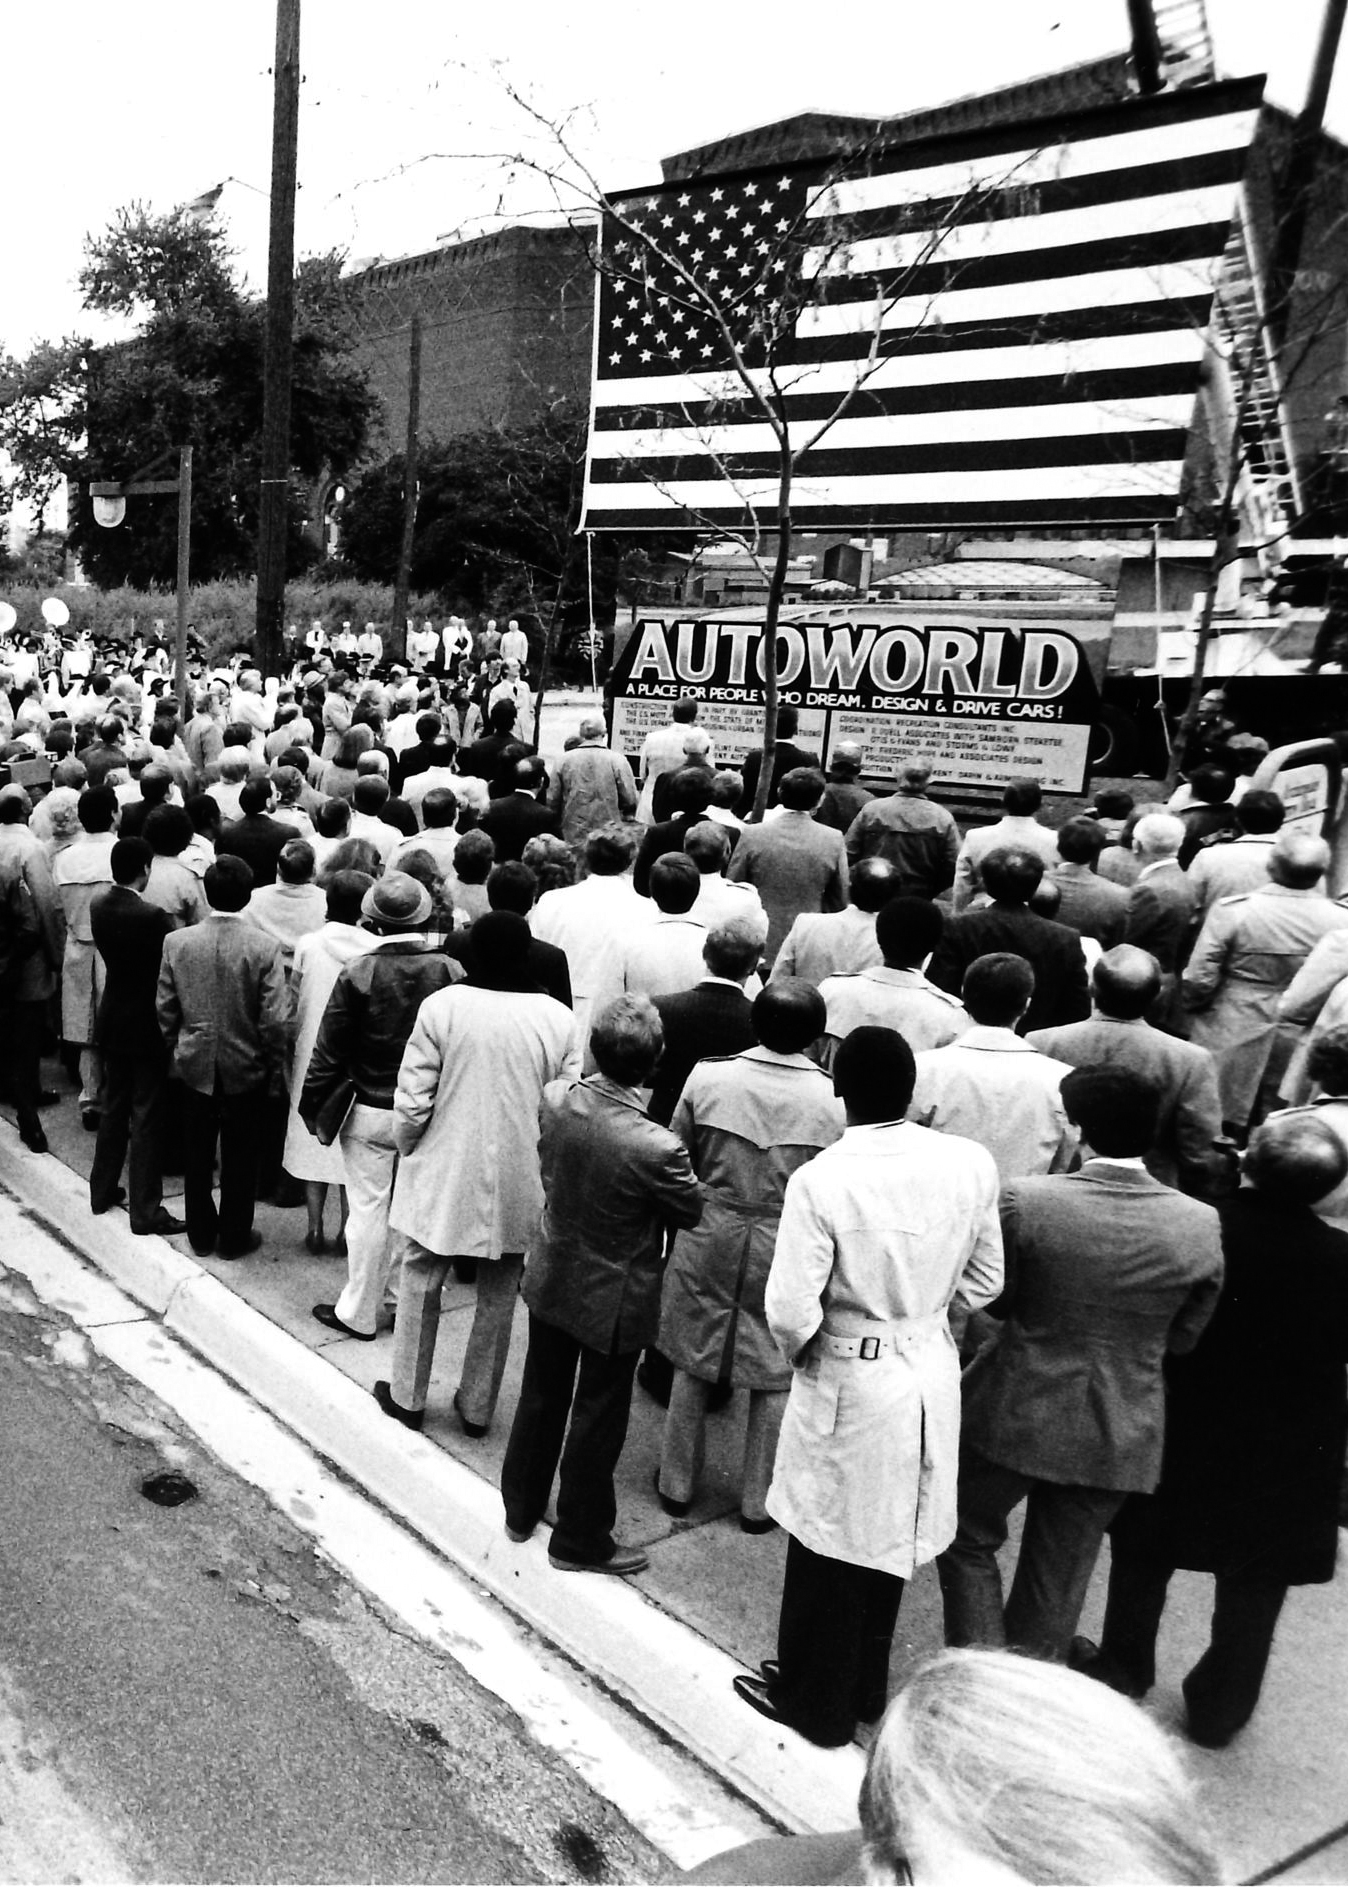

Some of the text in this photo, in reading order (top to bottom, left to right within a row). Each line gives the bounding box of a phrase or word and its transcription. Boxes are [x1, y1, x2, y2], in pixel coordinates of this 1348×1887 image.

[628, 622, 1079, 699] AUTOWORLD
[626, 684, 635, 695] A
[638, 684, 678, 698] PLACE
[680, 686, 707, 699] FOR
[709, 687, 758, 702] PEOPLE
[871, 696, 929, 712] DESIGN
[935, 700, 947, 713] &
[952, 700, 1001, 716] DRIVE
[1006, 702, 1064, 719] CARS!
